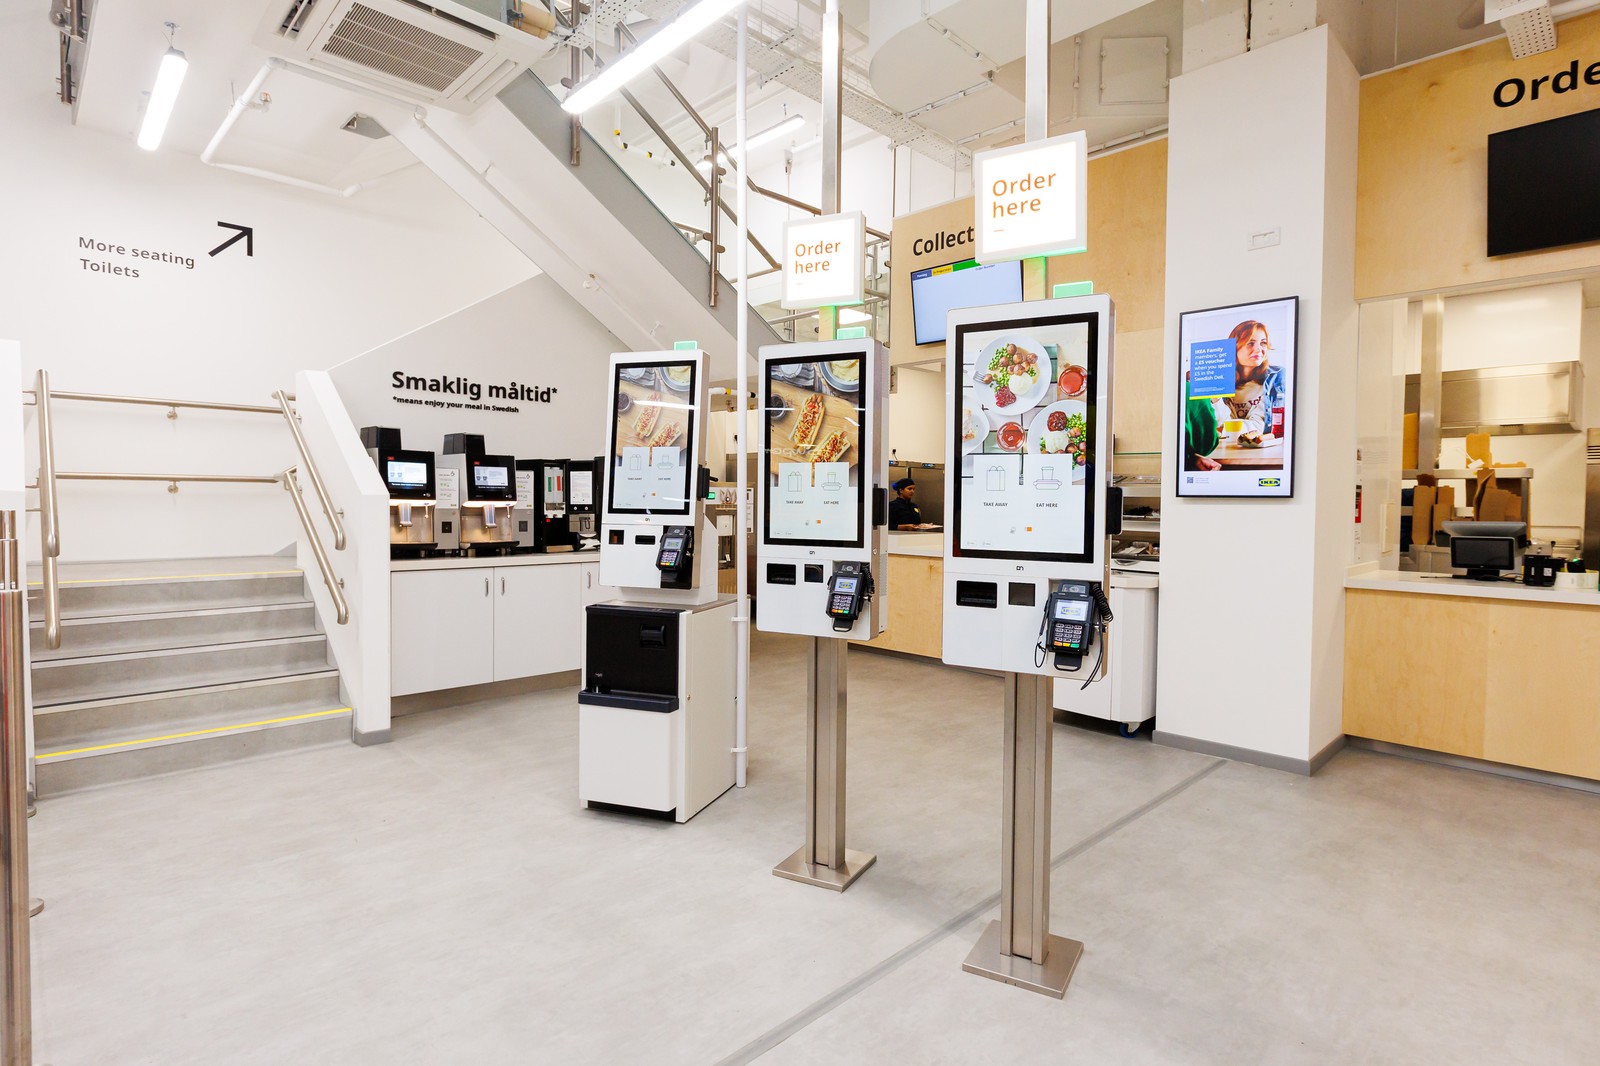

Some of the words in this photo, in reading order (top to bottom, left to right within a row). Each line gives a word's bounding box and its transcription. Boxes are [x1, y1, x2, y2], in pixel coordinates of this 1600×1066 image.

[992, 172, 1057, 197] Order
[992, 198, 1042, 219] here
[795, 240, 841, 257] Order
[912, 226, 975, 257] Collect
[79, 236, 126, 255] More
[131, 248, 195, 270] seating
[79, 258, 140, 278] Toilets
[795, 260, 830, 274] here
[1206, 346, 1223, 354] Family
[1217, 362, 1232, 370] spend
[391, 371, 482, 401] Smaklig
[424, 399, 445, 408] enjoy
[445, 401, 463, 409] your
[464, 402, 483, 410] meal
[483, 403, 491, 411] in
[491, 405, 520, 413] Swedish
